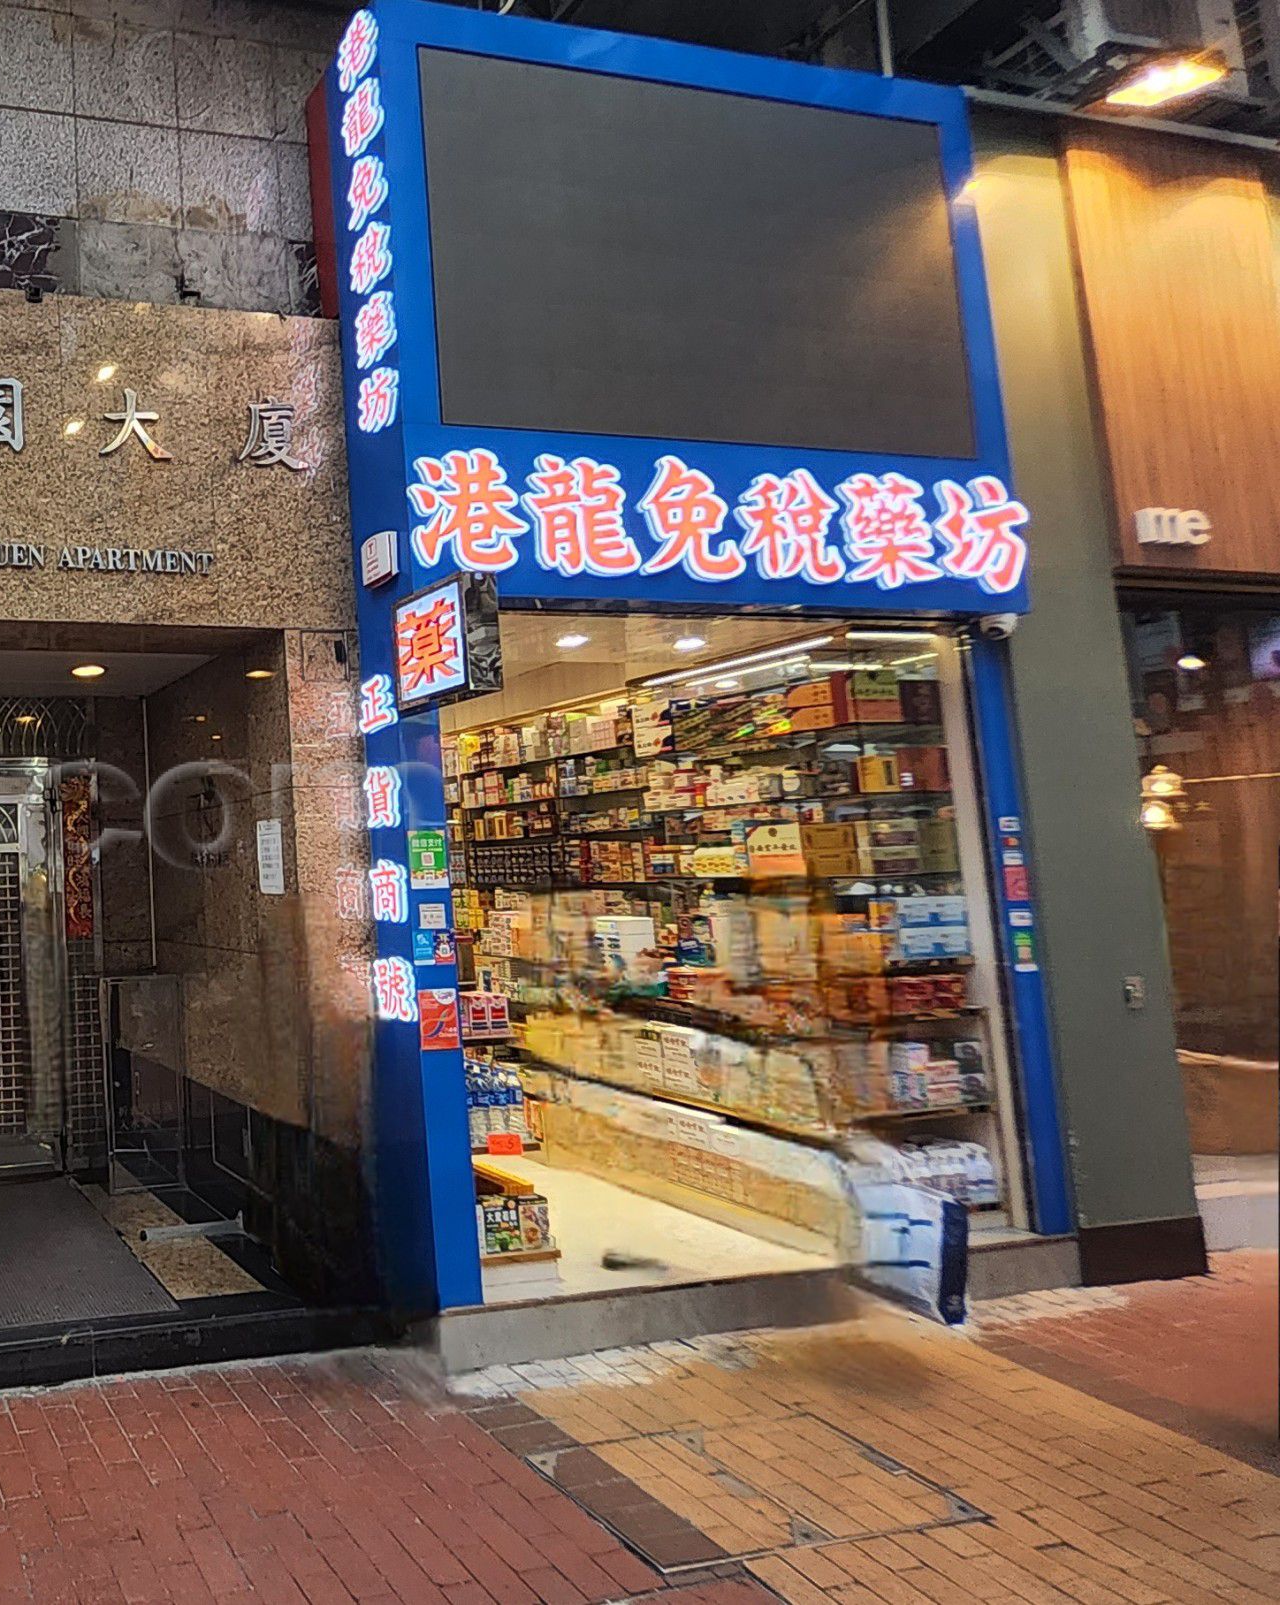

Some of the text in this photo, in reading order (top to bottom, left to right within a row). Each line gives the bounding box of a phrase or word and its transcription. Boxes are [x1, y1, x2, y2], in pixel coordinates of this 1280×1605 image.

[56, 546, 215, 576] APARTMENT
[358, 673, 419, 1023] 正貨商號
